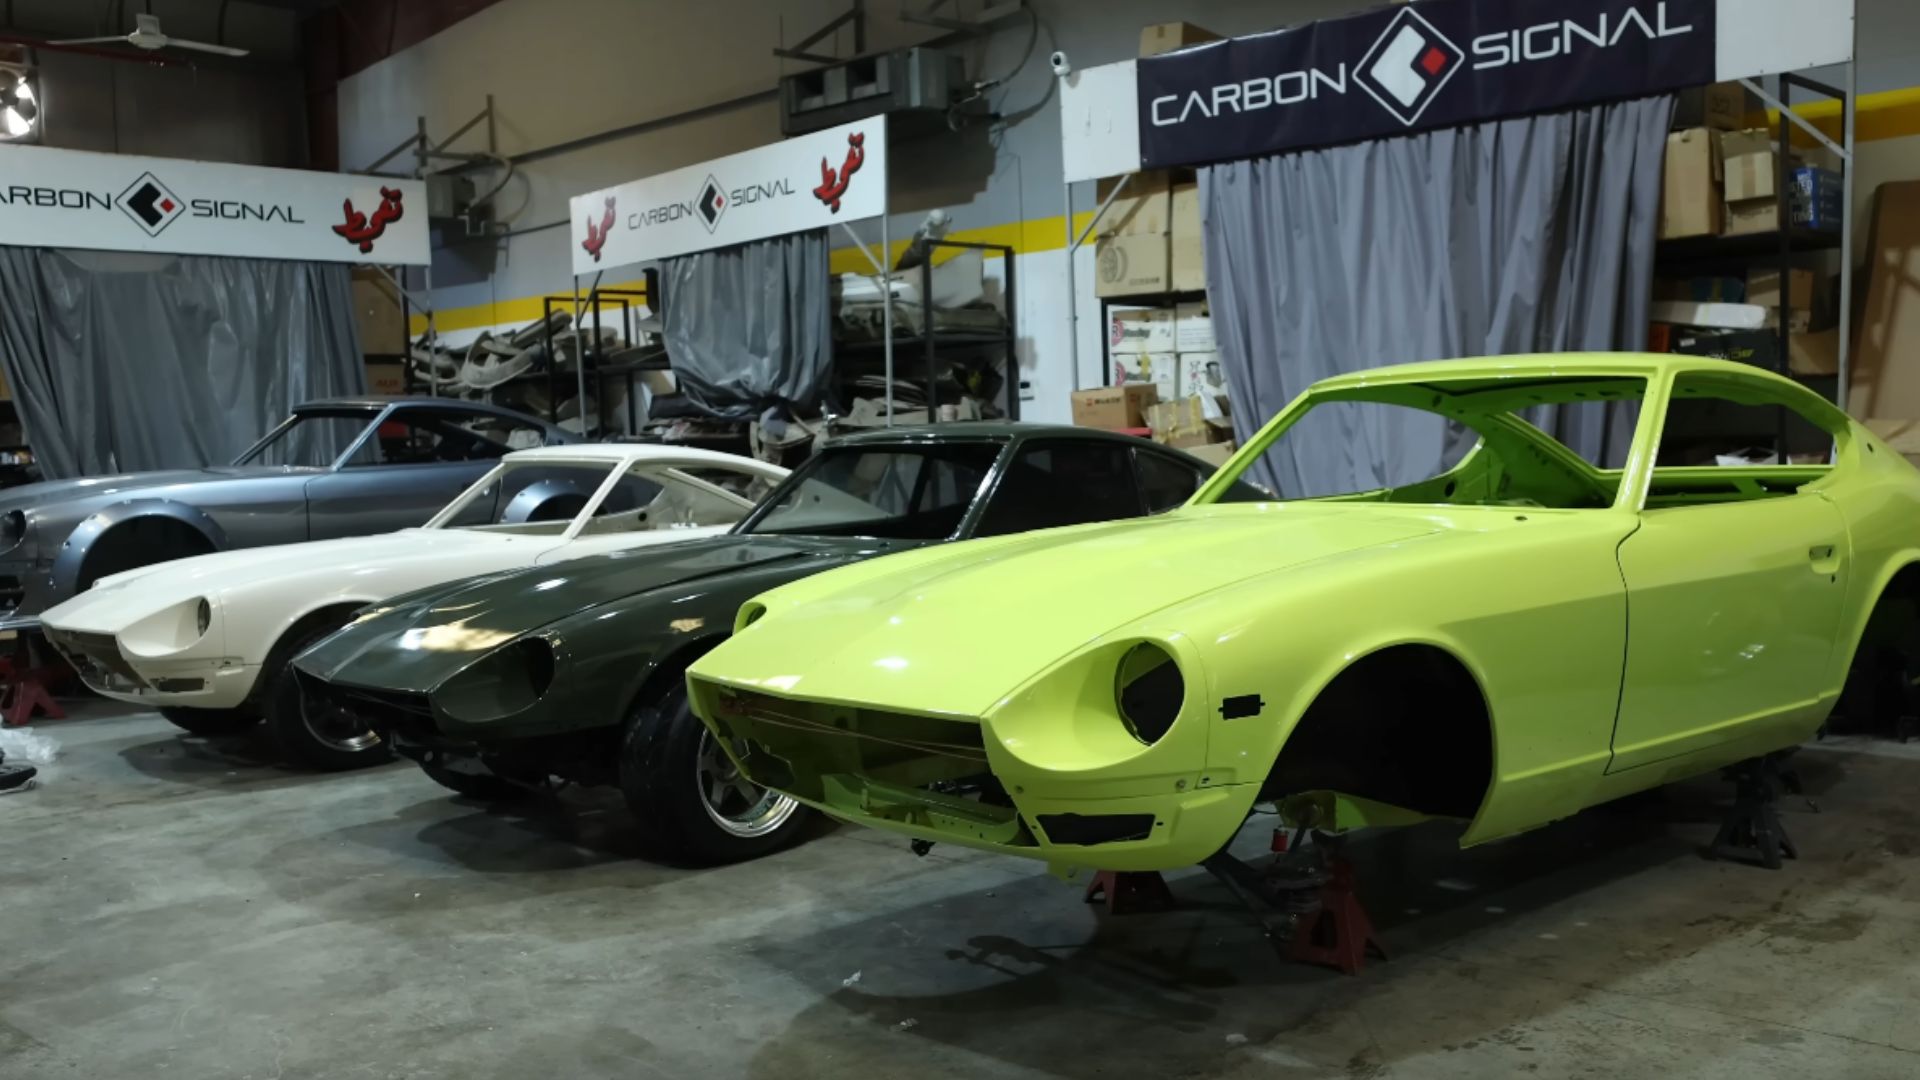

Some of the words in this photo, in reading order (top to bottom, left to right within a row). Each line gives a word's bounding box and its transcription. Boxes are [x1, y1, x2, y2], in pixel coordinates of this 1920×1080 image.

[1152, 63, 1347, 127] CARBON
[1472, 1, 1693, 71] SIGNAL
[190, 198, 305, 225] SIGNAL
[627, 199, 694, 231] CARBON
[730, 177, 796, 208] SIGNAL
